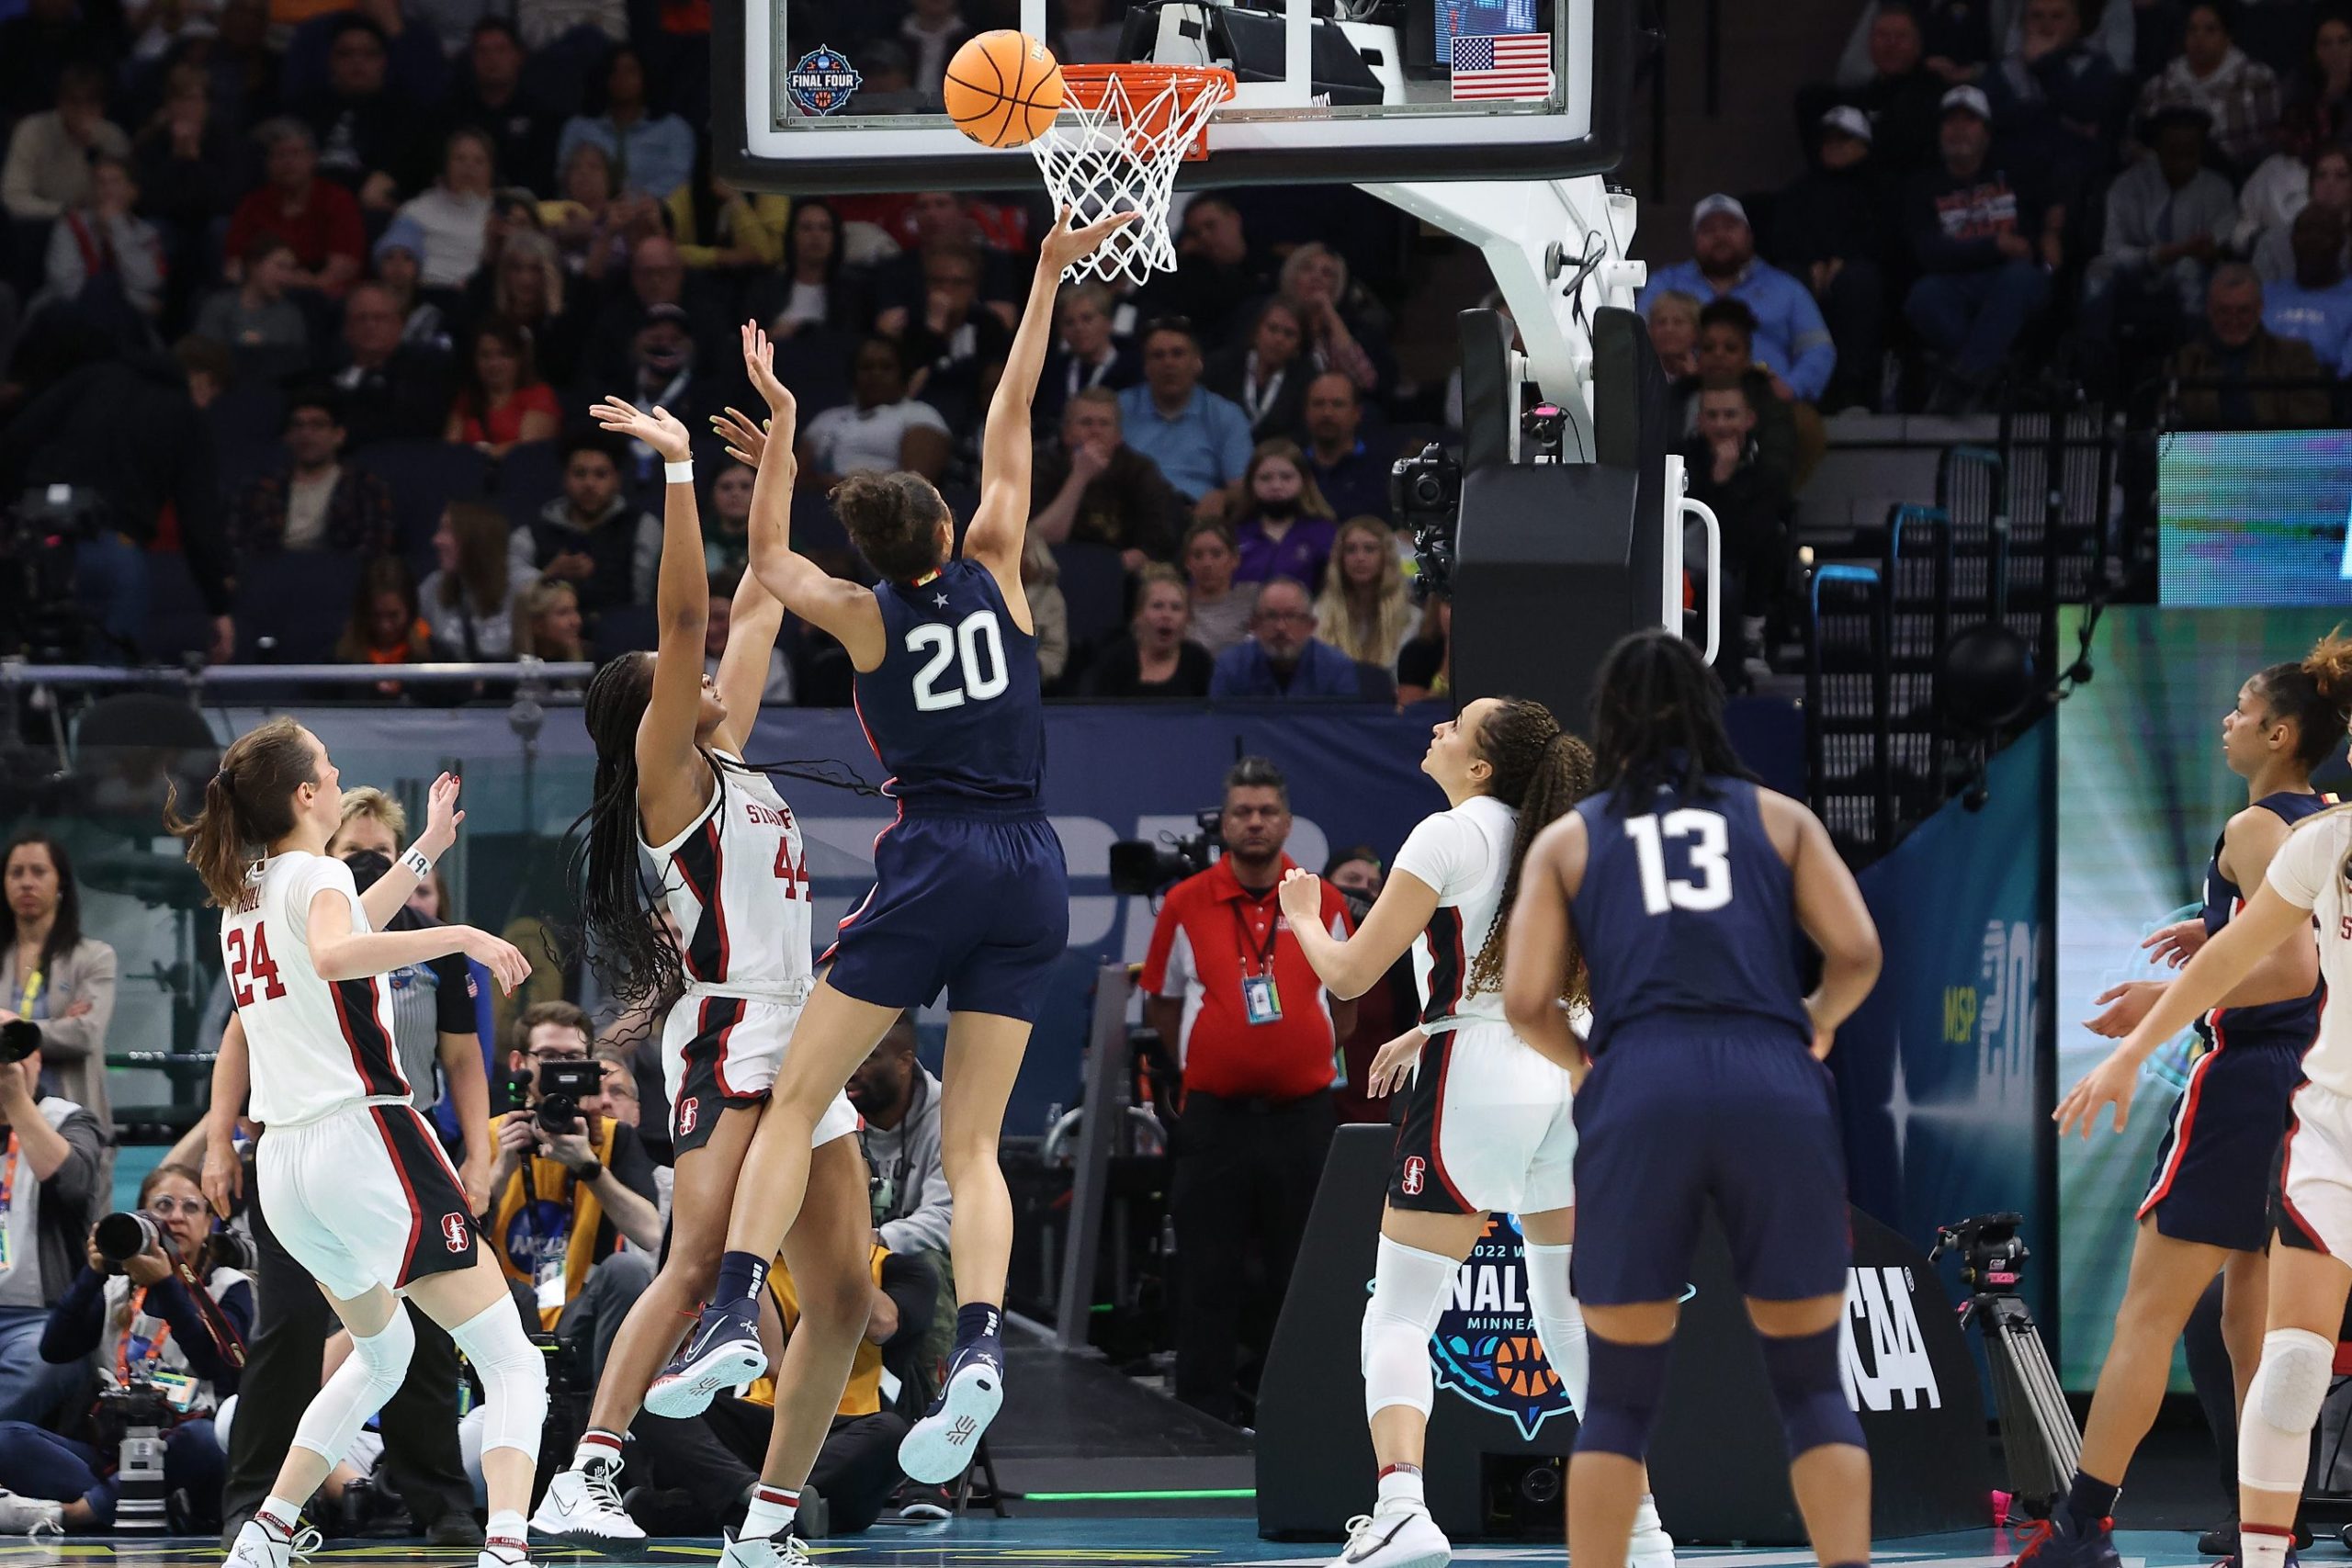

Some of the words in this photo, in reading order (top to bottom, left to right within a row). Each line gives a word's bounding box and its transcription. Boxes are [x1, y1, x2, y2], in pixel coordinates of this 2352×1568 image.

[793, 74, 822, 86] FINAL
[825, 74, 854, 86] FOUR
[905, 610, 1010, 711] 20
[1623, 807, 1734, 916] 13
[227, 920, 287, 1008] 24
[1943, 986, 1977, 1043] MSP
[1470, 1245, 1507, 1258] 022
